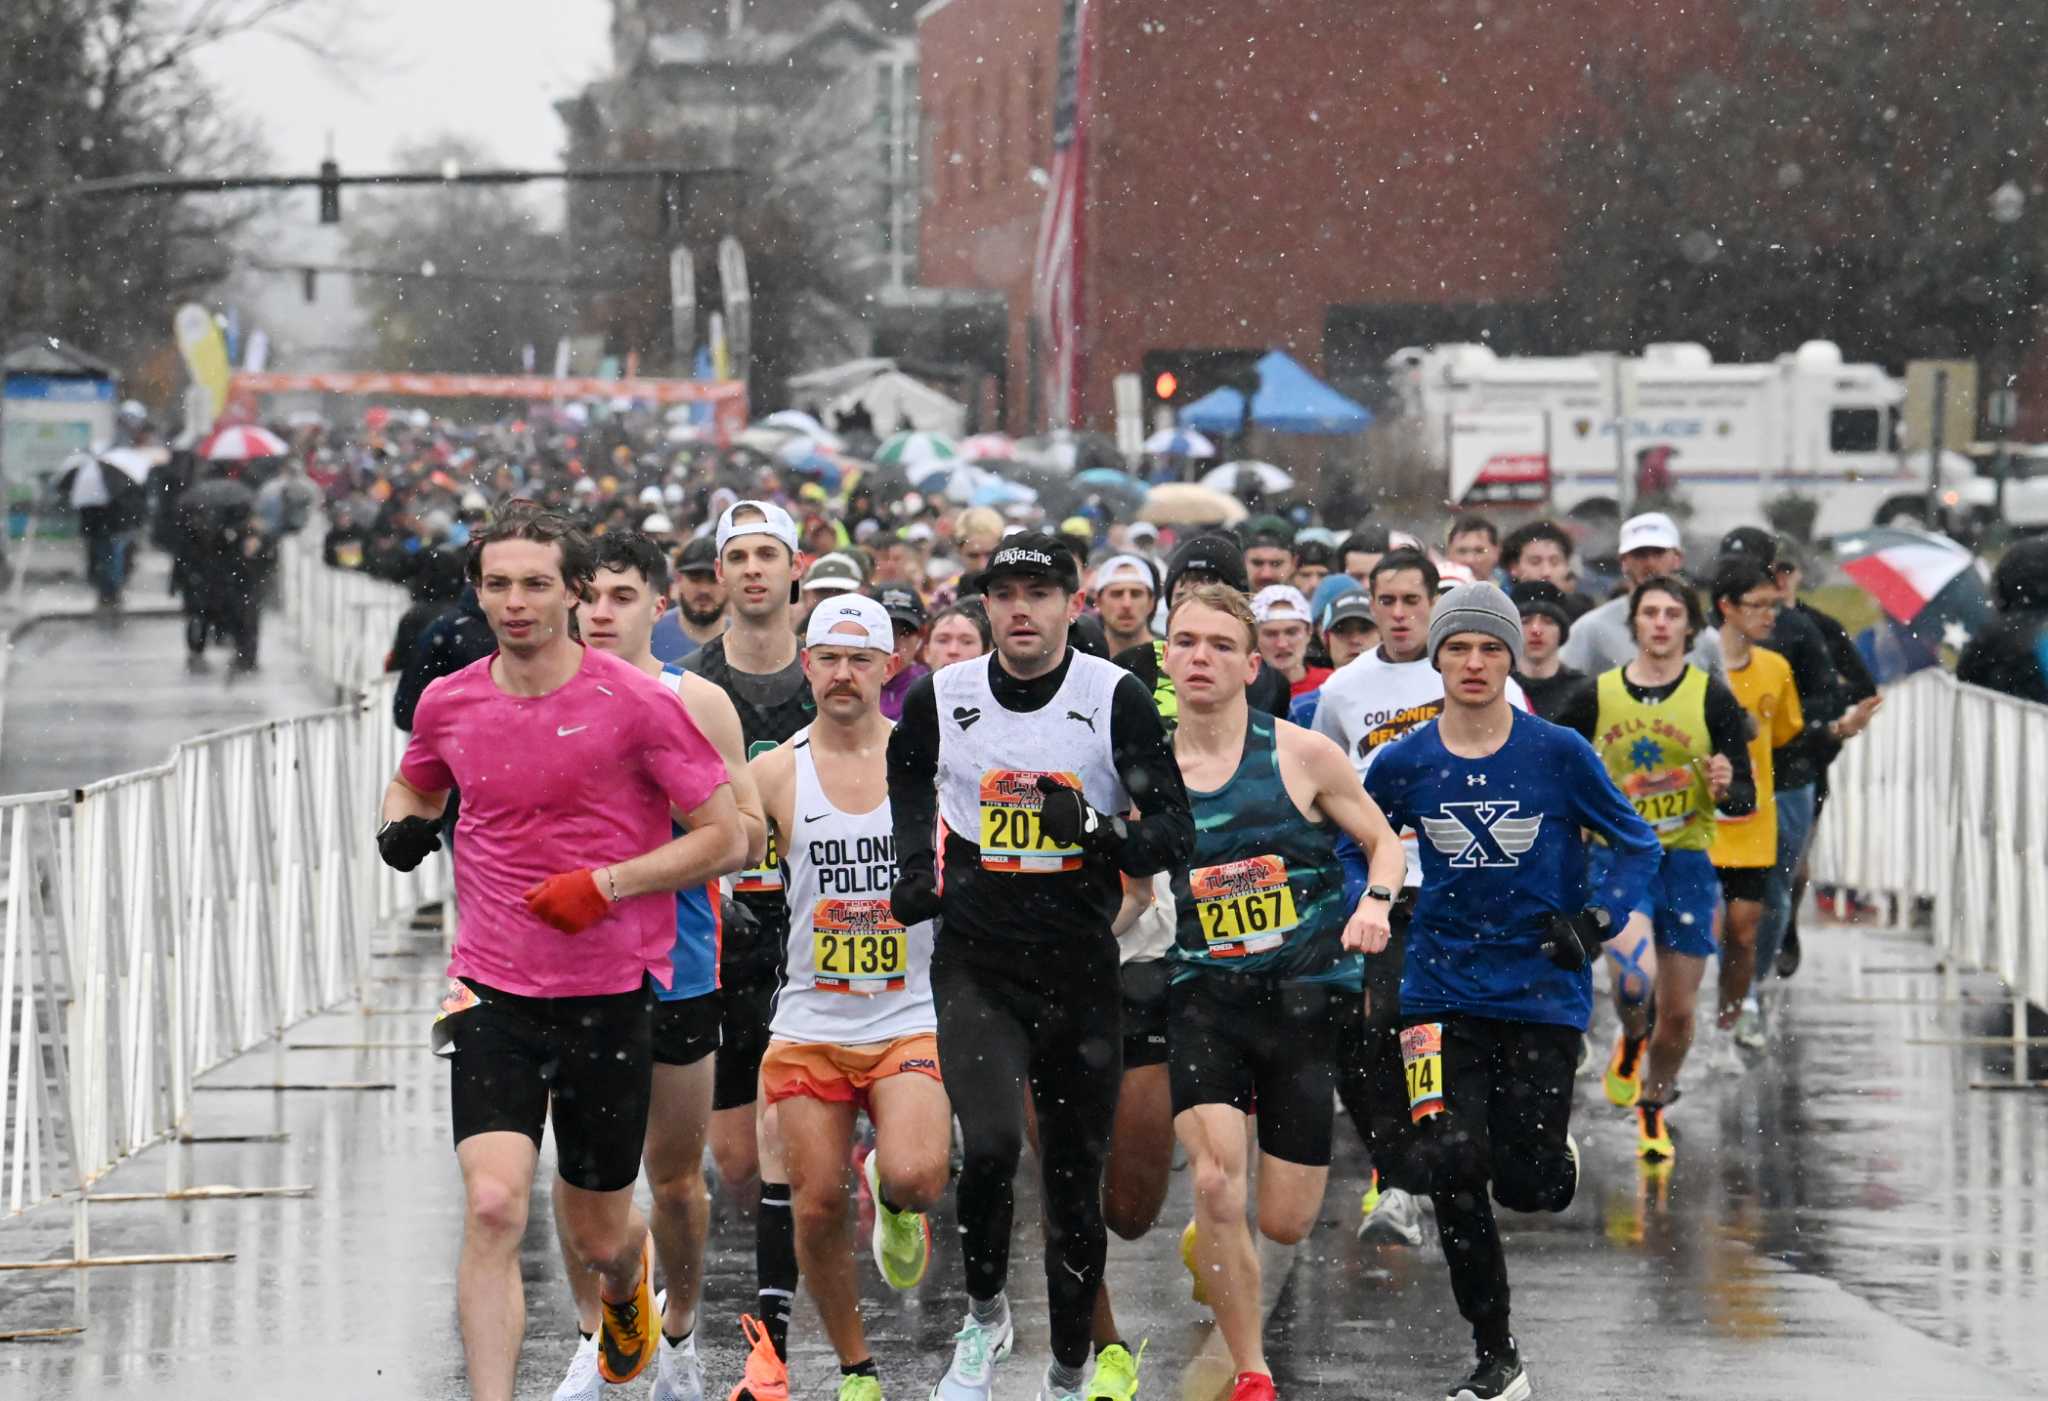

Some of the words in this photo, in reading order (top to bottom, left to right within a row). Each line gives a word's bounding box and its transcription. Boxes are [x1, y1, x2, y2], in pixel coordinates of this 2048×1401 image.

[993, 549, 1052, 566] magazine
[1364, 706, 1439, 726] COLONIE
[1635, 790, 1688, 818] 2127
[990, 808, 1072, 849] 207
[1440, 801, 1519, 868] X
[809, 835, 896, 865] COLONI
[1207, 891, 1282, 938] 2167
[822, 936, 898, 973] 2139
[1405, 1058, 1434, 1098] 74
